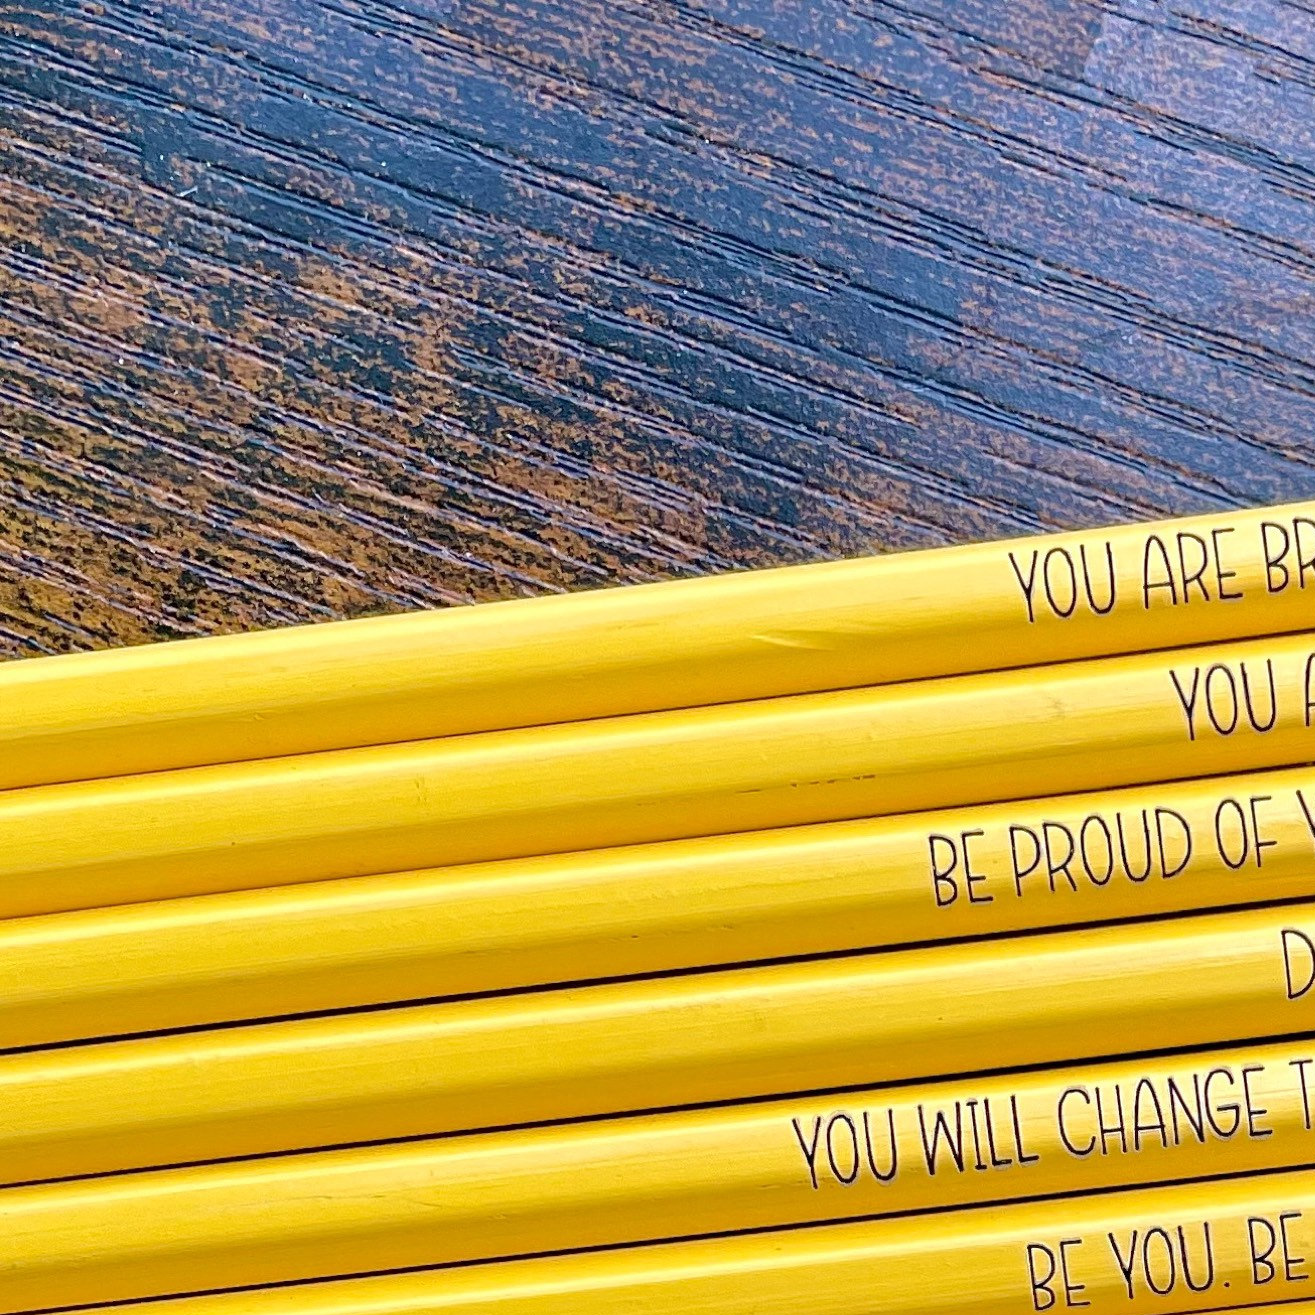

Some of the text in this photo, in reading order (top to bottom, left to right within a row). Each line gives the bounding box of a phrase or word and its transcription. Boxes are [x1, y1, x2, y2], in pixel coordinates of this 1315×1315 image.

[1008, 542, 1116, 624] YOU
[1142, 528, 1245, 611] ARE
[1169, 658, 1277, 742] YOU
[928, 831, 995, 908] BE
[1009, 808, 1193, 898] PROUD
[1215, 796, 1279, 871] OF
[791, 1108, 899, 1191] YOU
[917, 1095, 1041, 1177] WILL
[1058, 1066, 1274, 1157] CHANGE
[1026, 1239, 1092, 1313] BE
[1107, 1221, 1234, 1301] YOU.
[1247, 1213, 1310, 1286] BE
